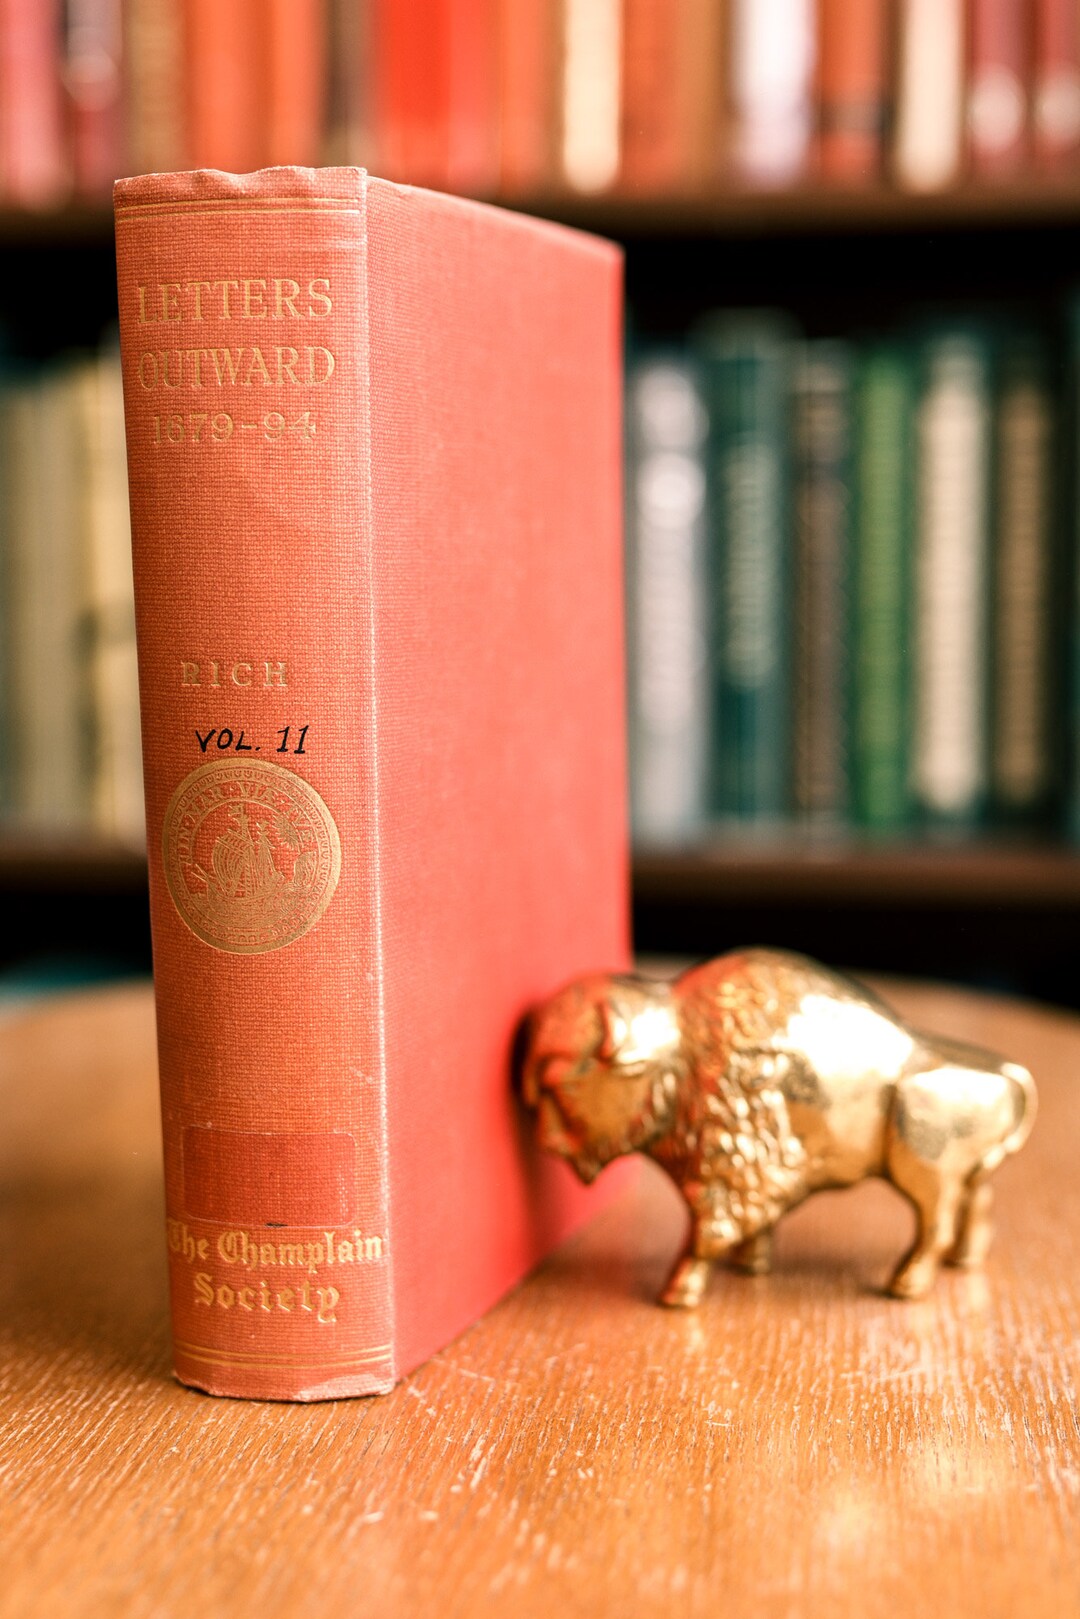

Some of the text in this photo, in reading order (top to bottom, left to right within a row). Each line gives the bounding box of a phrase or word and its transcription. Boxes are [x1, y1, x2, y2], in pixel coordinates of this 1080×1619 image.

[138, 278, 333, 323] LETTERS
[139, 346, 335, 390] OUTWARD
[180, 661, 288, 688] RICH
[195, 724, 309, 754] VOL. 11
[168, 1220, 383, 1274] The Champlain
[194, 1272, 340, 1323] Society
